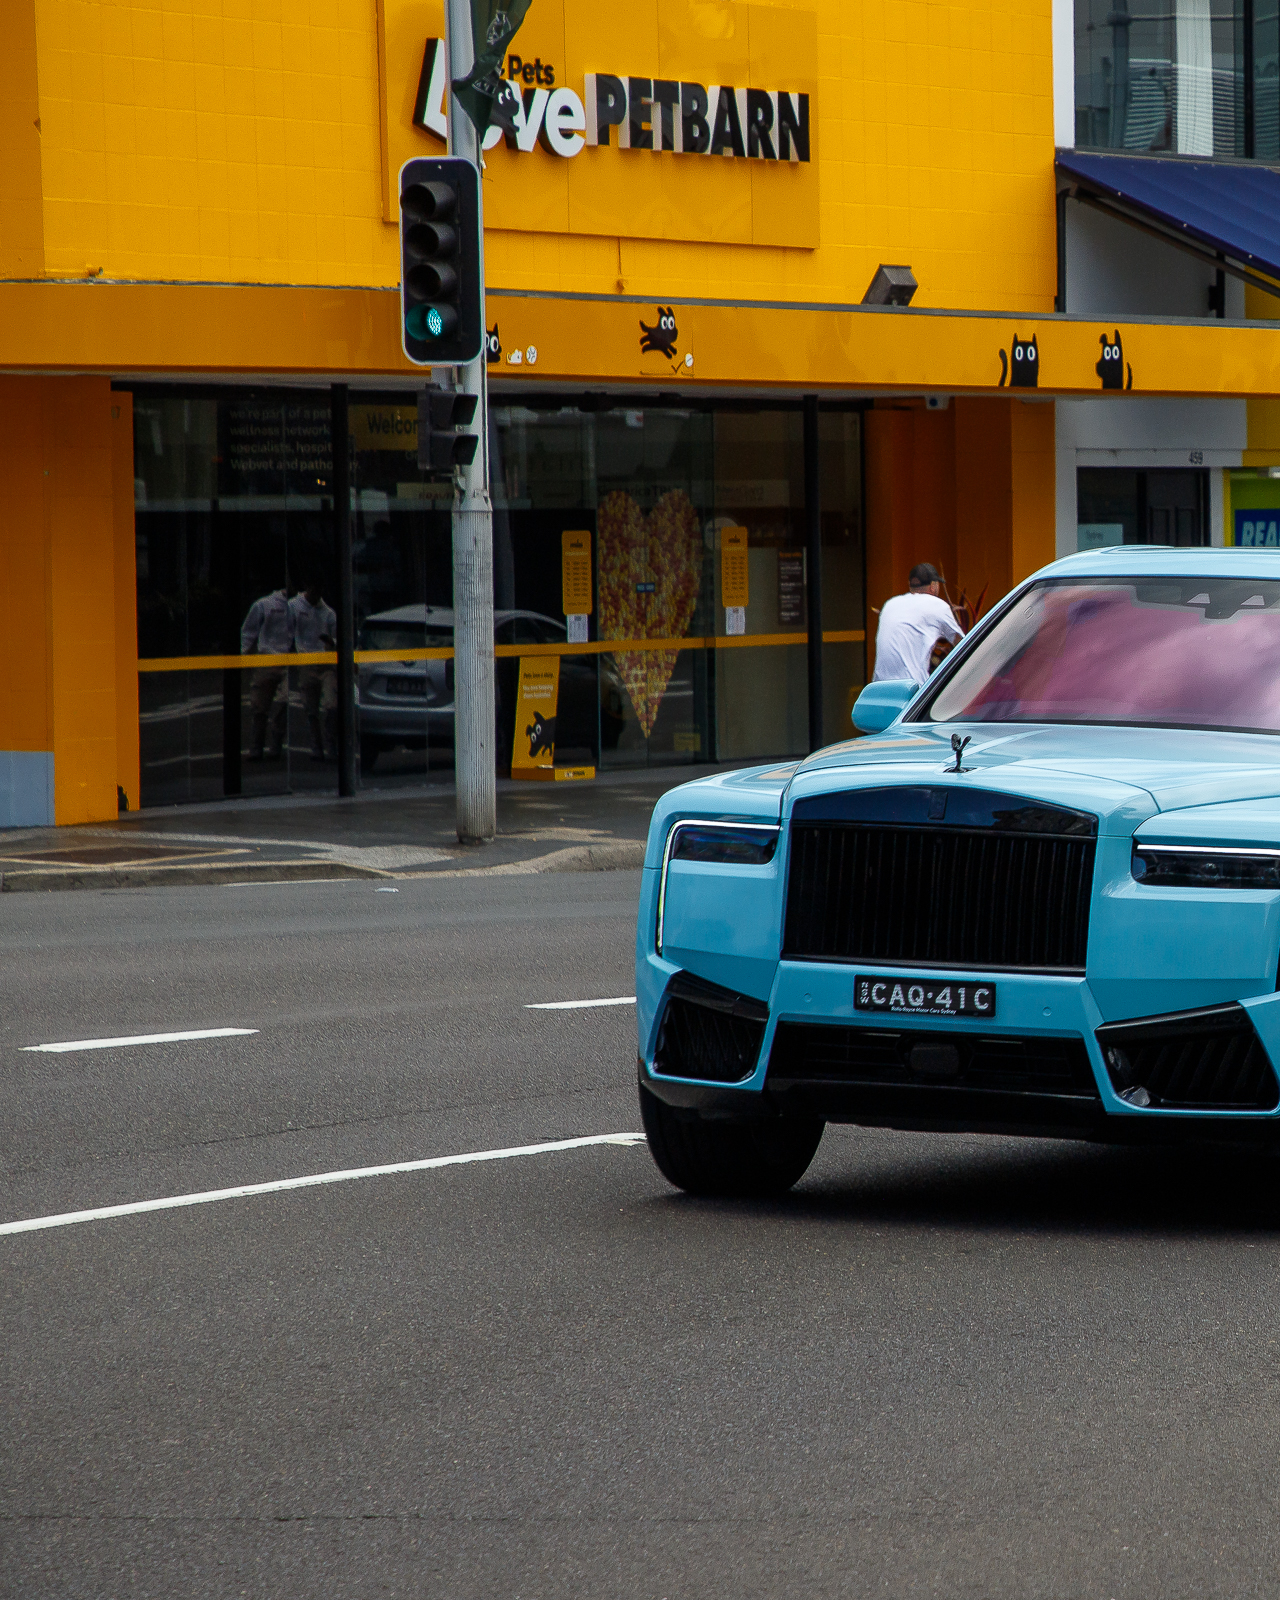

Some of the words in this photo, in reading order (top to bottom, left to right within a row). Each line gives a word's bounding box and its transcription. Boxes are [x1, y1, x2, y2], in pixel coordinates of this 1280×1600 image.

[412, 37, 586, 158] Lve
[584, 72, 810, 163] PETBARN
[508, 54, 555, 86] Pets
